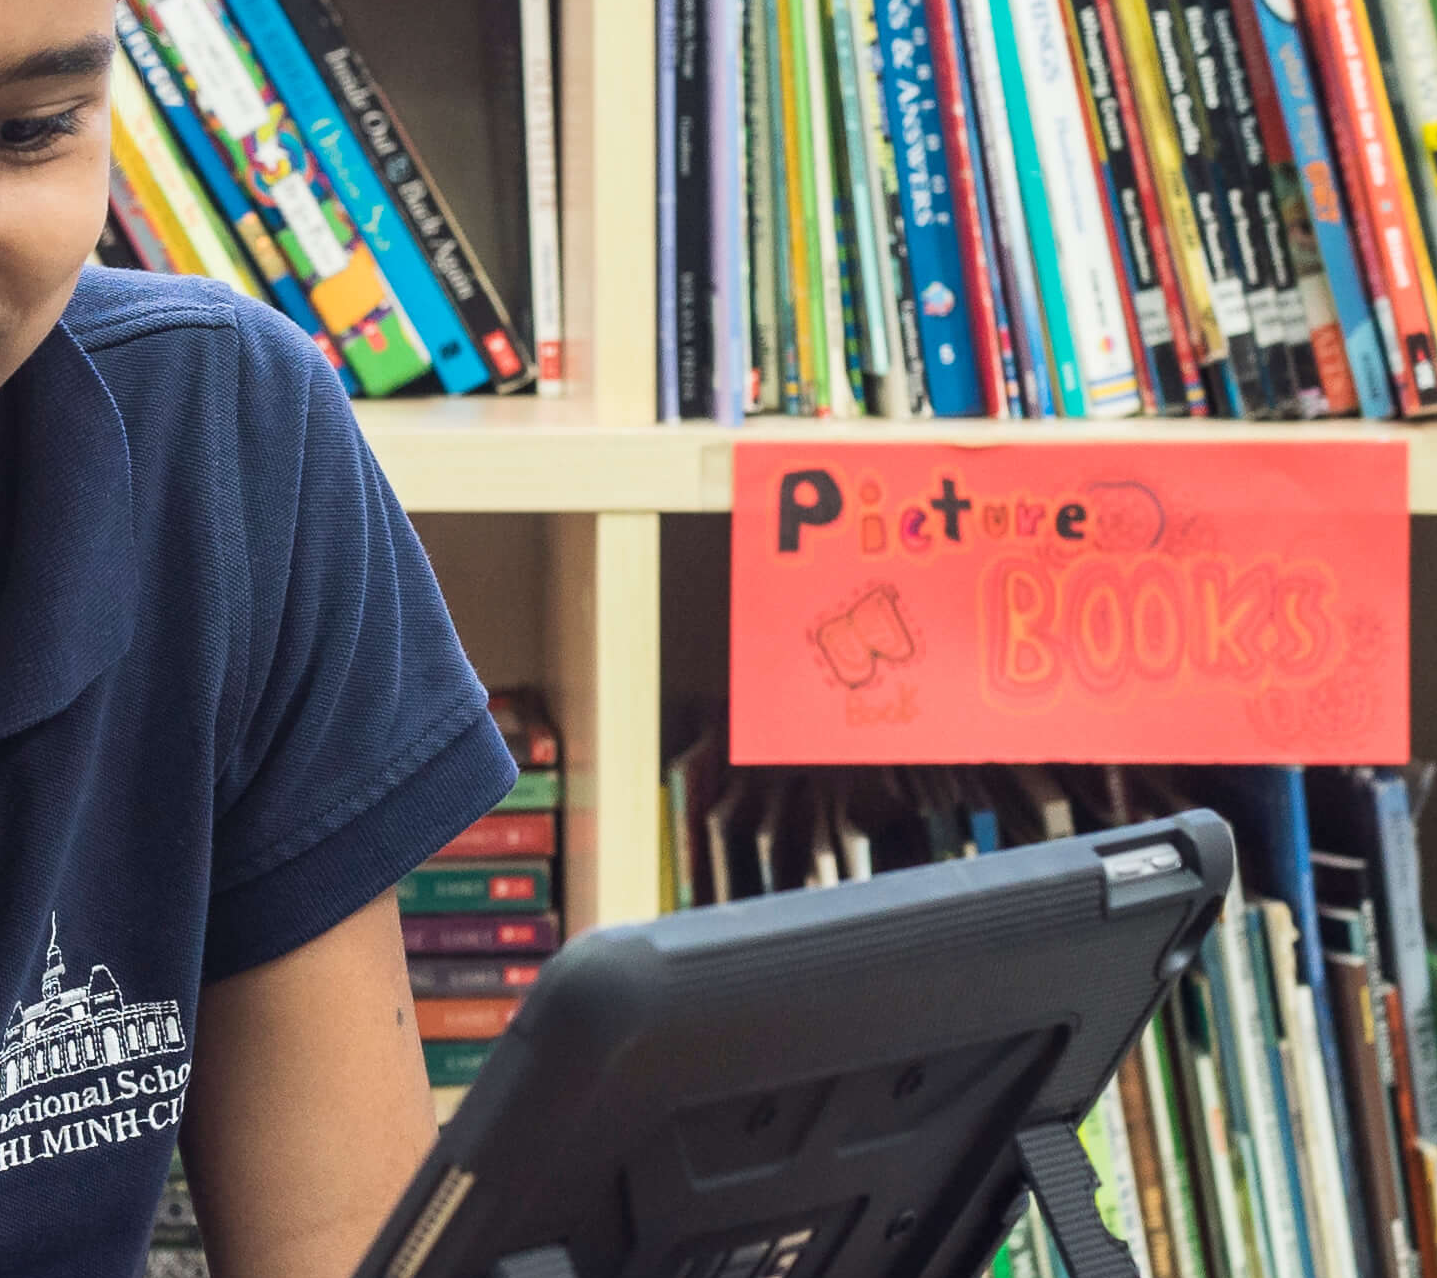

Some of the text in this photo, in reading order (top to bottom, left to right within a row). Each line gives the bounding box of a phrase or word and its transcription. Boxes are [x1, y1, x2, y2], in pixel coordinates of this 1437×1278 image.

[320, 40, 380, 112] Inside
[354, 104, 403, 159] Out
[395, 173, 450, 240] Back
[893, 76, 938, 227] ANSWERS
[776, 466, 1090, 555] Picture
[998, 563, 1322, 685] BOOKS
[40, 1108, 142, 1158] MINH
[147, 1093, 187, 1131] CI
